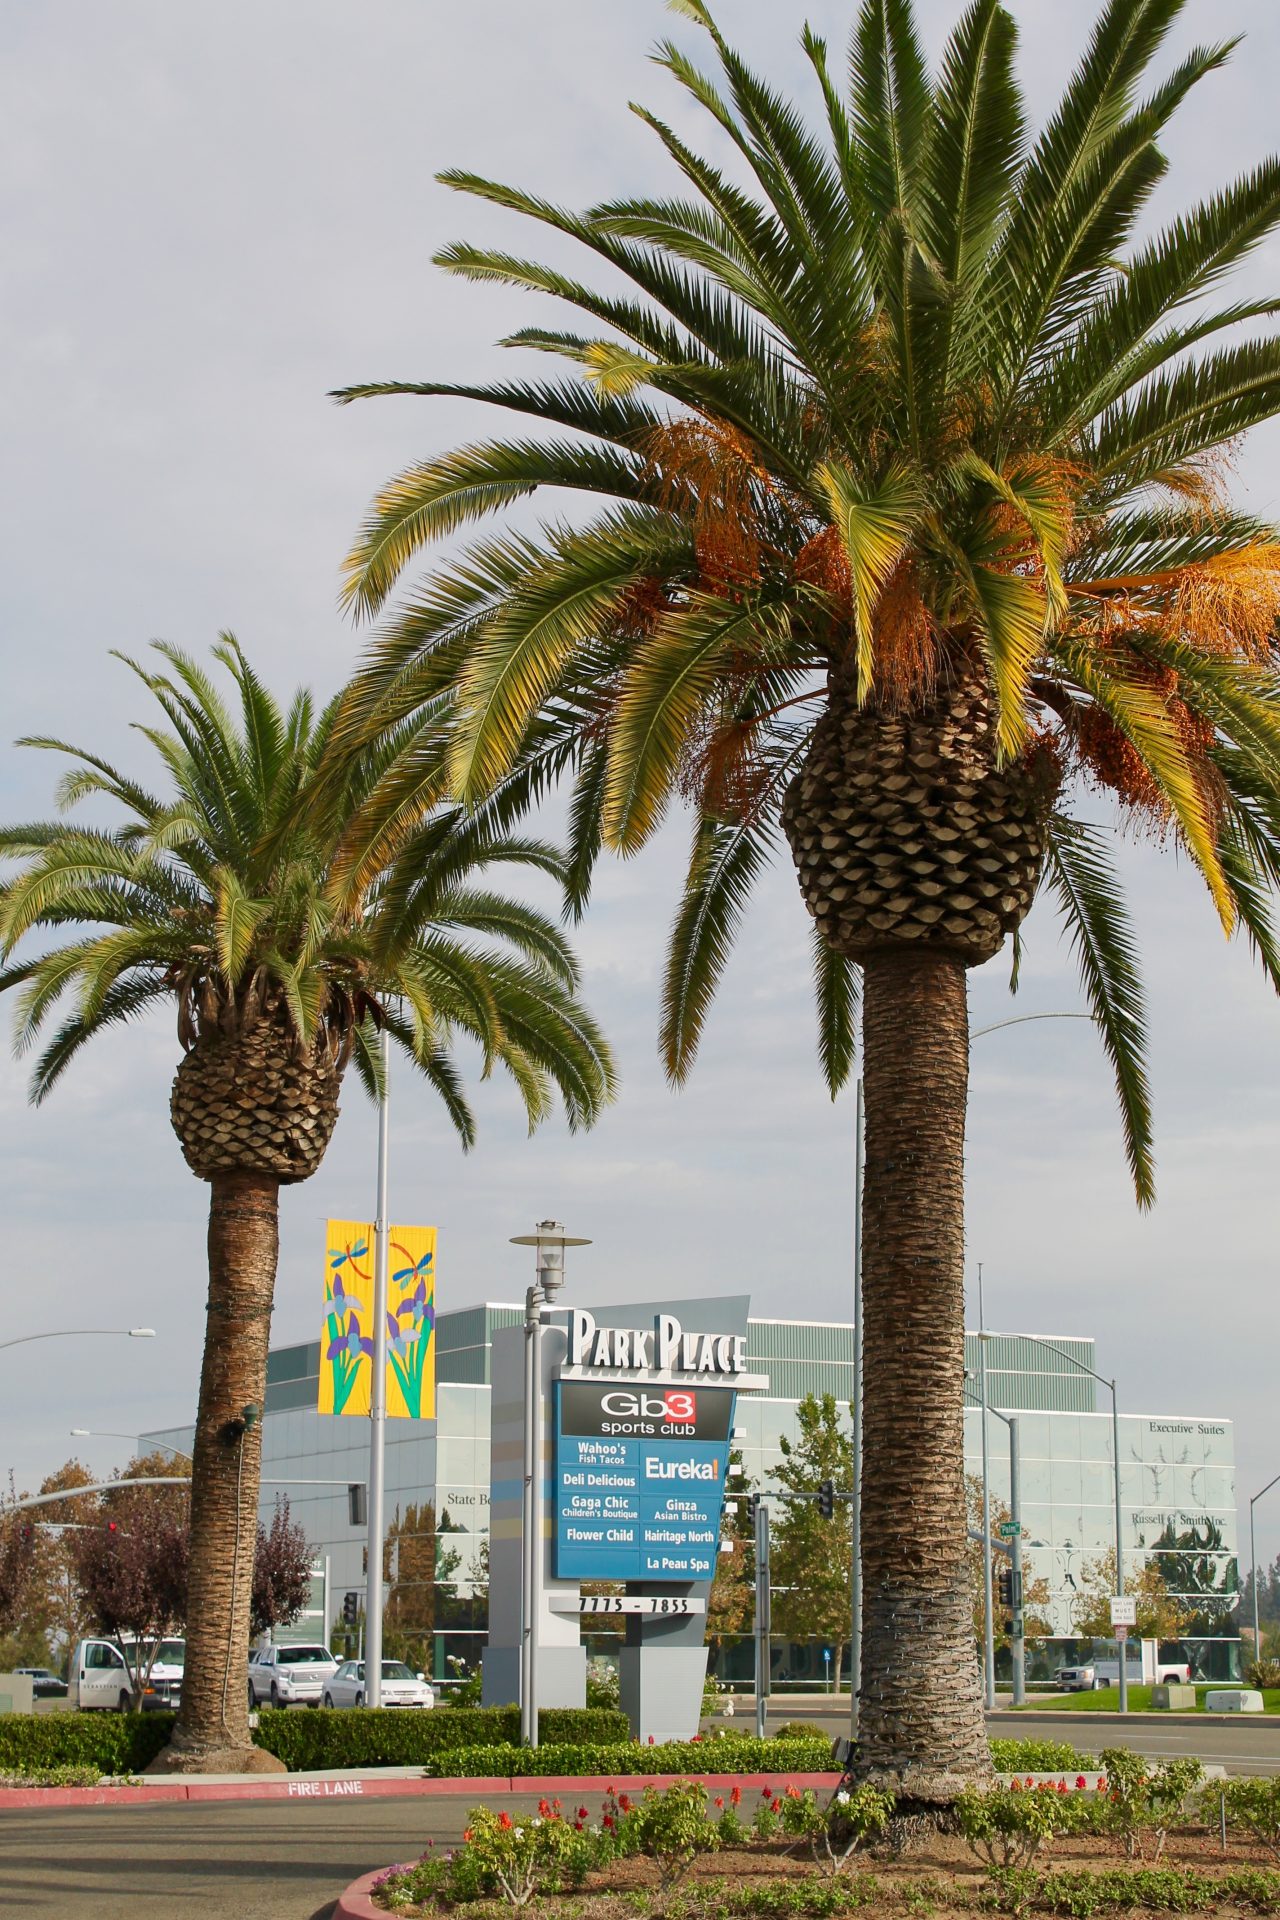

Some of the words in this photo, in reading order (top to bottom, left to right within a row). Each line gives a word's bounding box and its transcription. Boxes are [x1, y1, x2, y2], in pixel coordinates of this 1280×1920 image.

[568, 1309, 650, 1368] PARK
[655, 1314, 747, 1373] PLACE
[600, 1392, 695, 1418] Gb3
[601, 1422, 655, 1435] sports
[660, 1422, 696, 1435] club
[1149, 1421, 1194, 1434] Executive
[1197, 1423, 1225, 1435] Suites
[578, 1441, 626, 1455] Wahoo's
[579, 1454, 597, 1464] Fish
[599, 1455, 625, 1465] Tacos
[645, 1457, 719, 1480] Eureka!
[563, 1473, 585, 1485] Deli
[587, 1474, 636, 1487] Delicious
[447, 1492, 476, 1505] State
[571, 1495, 601, 1510] Gaga
[604, 1496, 629, 1509] Chic
[666, 1499, 697, 1511] Ginza
[562, 1508, 601, 1518] Children's
[602, 1509, 638, 1520] Boutique
[654, 1511, 679, 1521] Asian
[681, 1511, 708, 1521] Bistro
[1132, 1513, 1164, 1524] Russell
[567, 1528, 604, 1541] Flower
[606, 1529, 634, 1542] Child
[644, 1529, 687, 1545] Hairitage
[688, 1530, 714, 1542] North
[647, 1557, 659, 1569] La
[662, 1558, 688, 1570] Peau
[690, 1558, 710, 1572] Spa
[579, 1598, 623, 1611] 7775
[651, 1599, 688, 1612] 7855
[288, 1782, 321, 1796] FIRE
[324, 1780, 364, 1795] LANE
